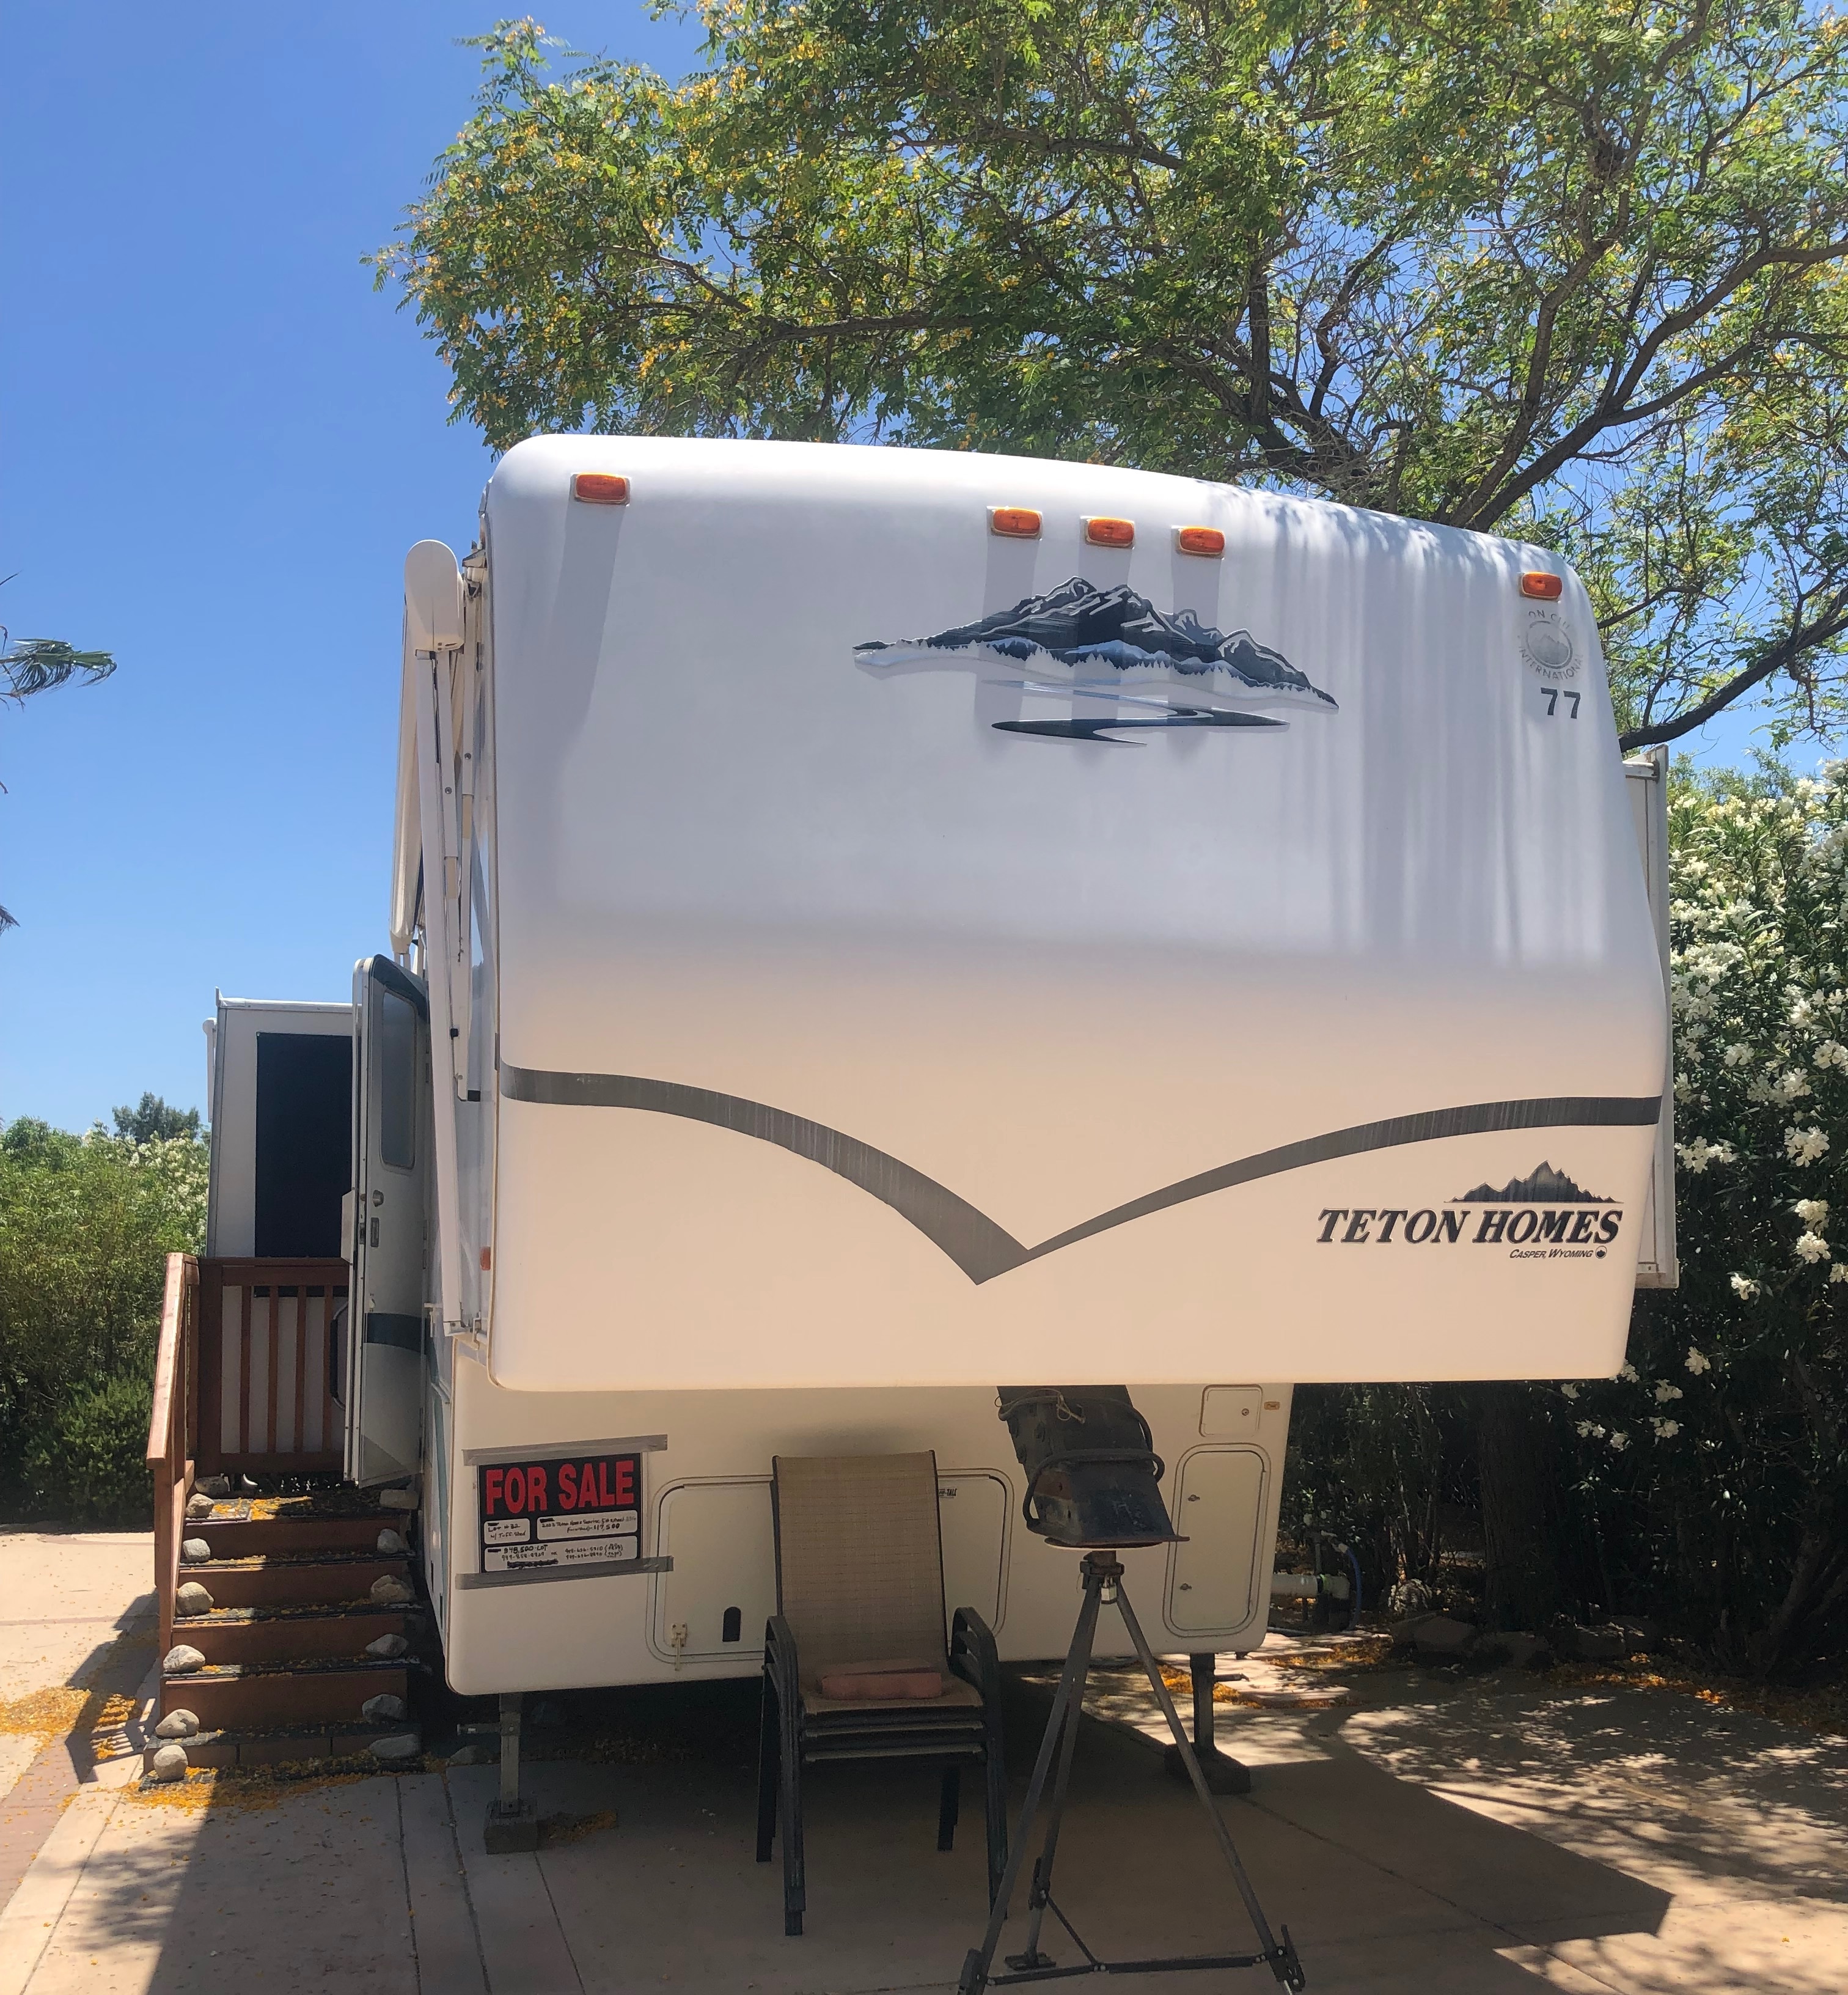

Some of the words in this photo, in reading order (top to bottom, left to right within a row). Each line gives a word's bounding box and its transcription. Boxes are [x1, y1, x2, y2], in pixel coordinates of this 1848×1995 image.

[1540, 687, 1581, 719] 77
[1316, 1208, 1471, 1244] TETON
[1472, 1209, 1624, 1244] HOMES
[1548, 1249, 1594, 1258] WYOMING
[486, 1467, 548, 1515] FOR
[558, 1460, 634, 1510] SALE
